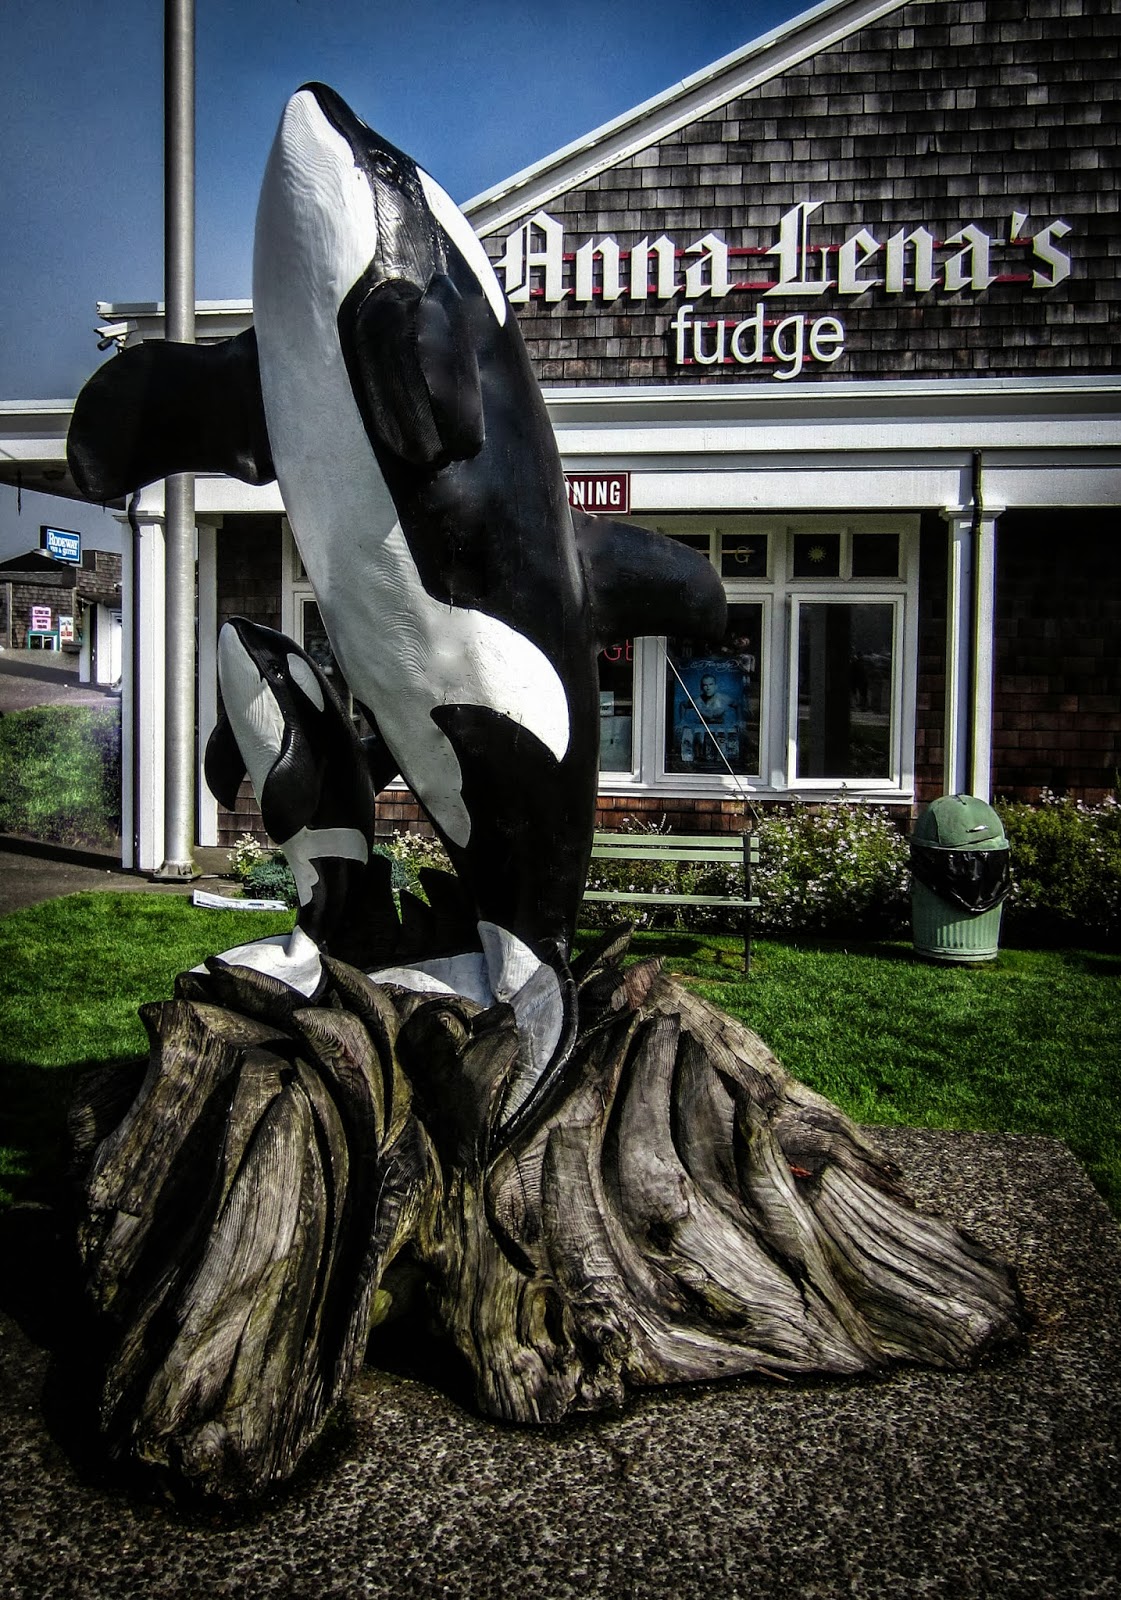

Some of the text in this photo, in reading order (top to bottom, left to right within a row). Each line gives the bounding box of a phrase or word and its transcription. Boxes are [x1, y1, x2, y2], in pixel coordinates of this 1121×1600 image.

[494, 201, 1072, 302] Anna Lena's
[671, 303, 845, 379] fudge
